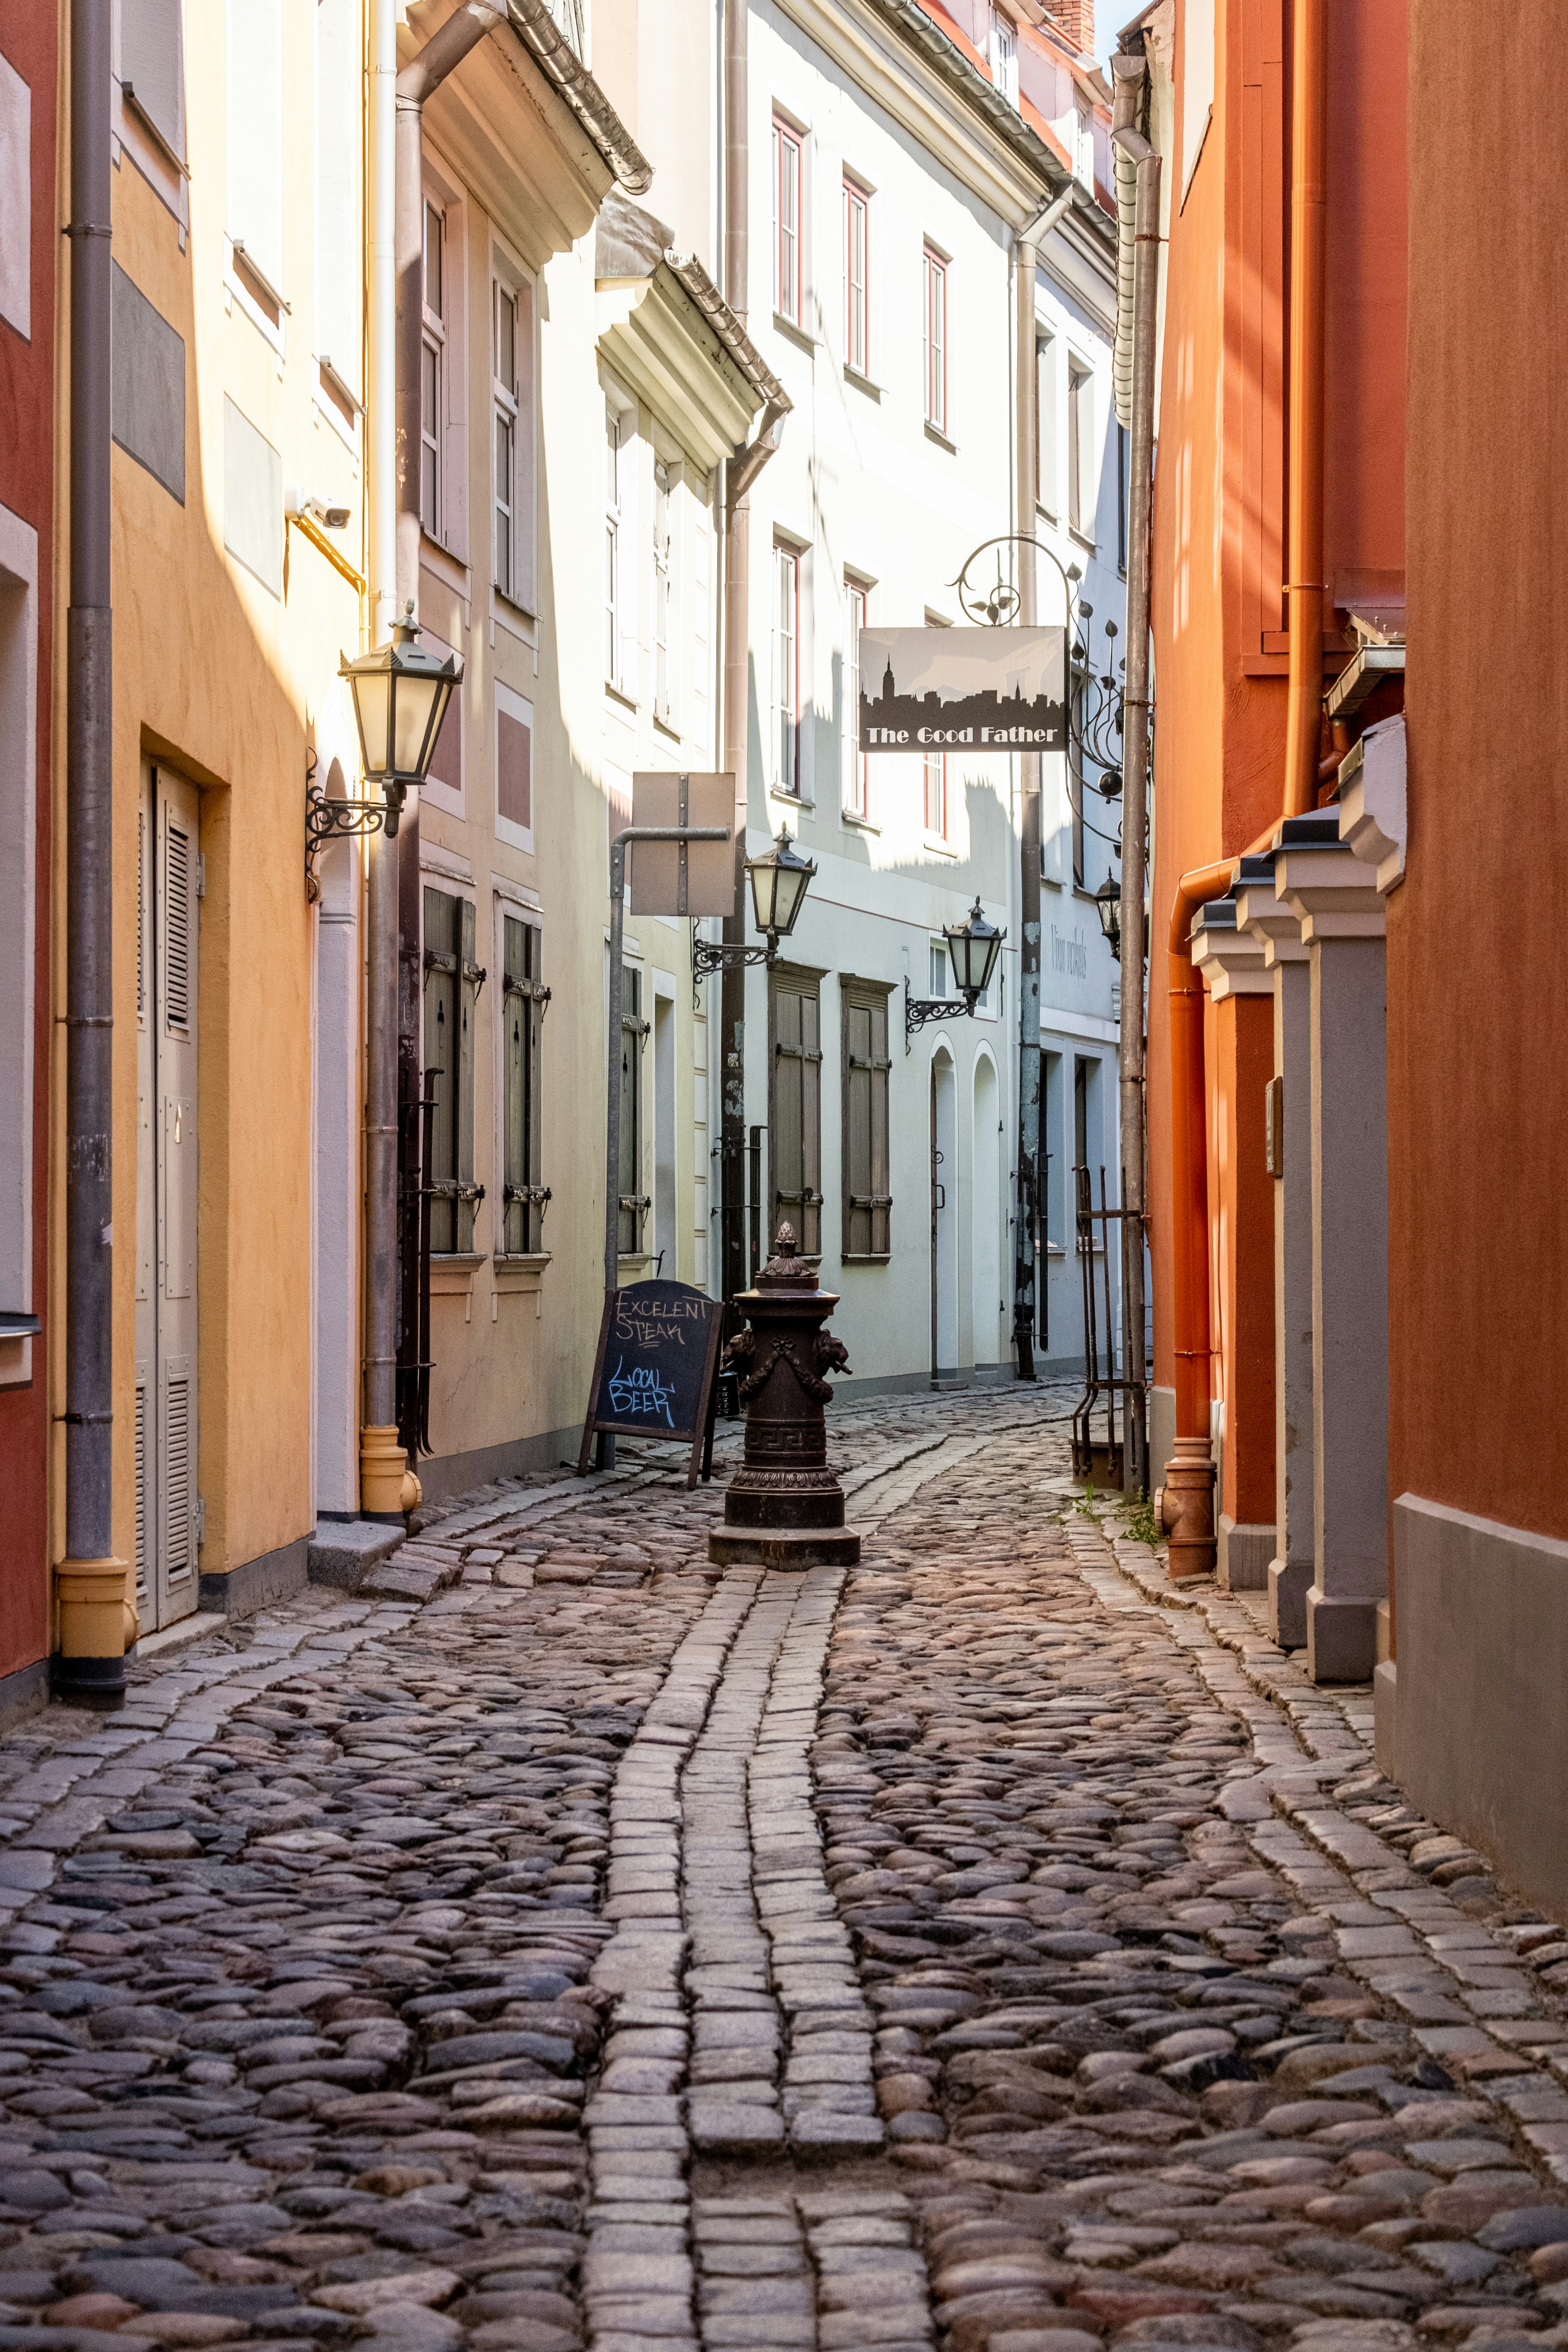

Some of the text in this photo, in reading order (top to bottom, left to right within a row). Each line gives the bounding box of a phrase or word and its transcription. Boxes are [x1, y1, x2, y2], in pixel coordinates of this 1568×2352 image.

[865, 726, 1058, 743] The Good Father
[616, 1290, 714, 1319] EXCELENT
[616, 1314, 686, 1345] STEAK
[608, 1354, 676, 1393] LOCAL
[609, 1383, 676, 1429] BEER
